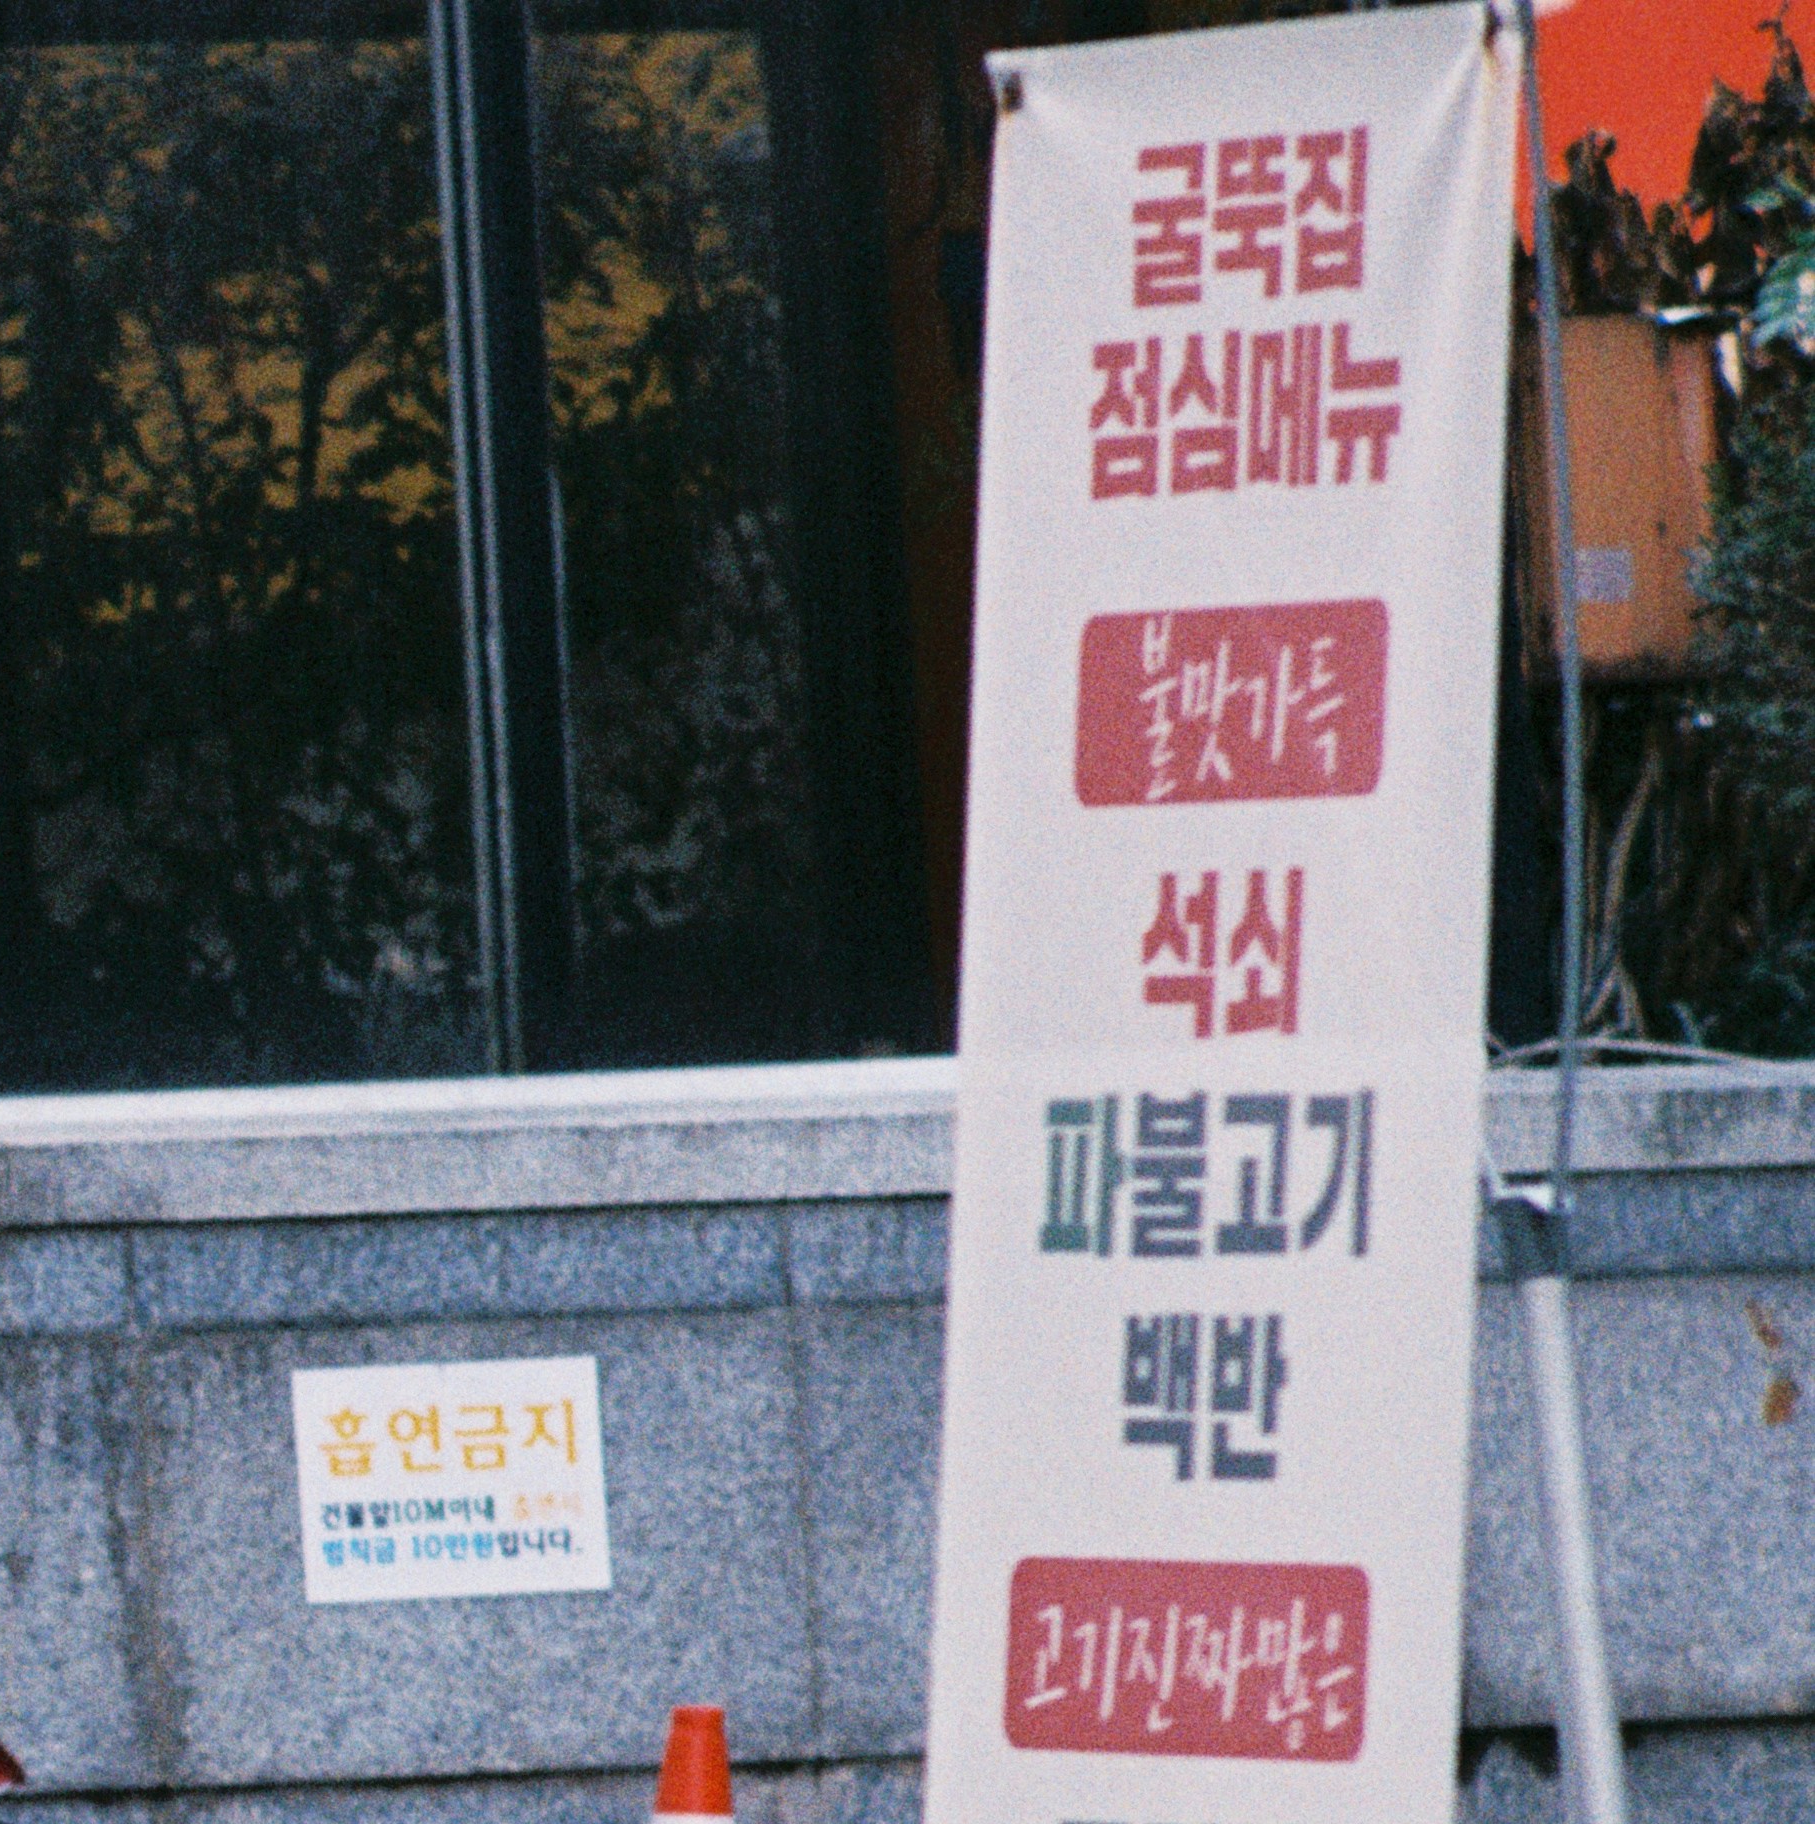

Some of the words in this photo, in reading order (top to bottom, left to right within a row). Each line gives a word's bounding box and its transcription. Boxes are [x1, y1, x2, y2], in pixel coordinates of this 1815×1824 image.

[1131, 123, 1369, 310] 굴뚝집
[1088, 320, 1401, 502] 점심메뉴
[1138, 614, 1345, 801] 불맛가득
[1141, 866, 1304, 1039] 석쇠
[1038, 1087, 1374, 1258] 파불고기
[318, 1397, 579, 1477] 흡연금지
[1122, 1312, 1289, 1482] 백반
